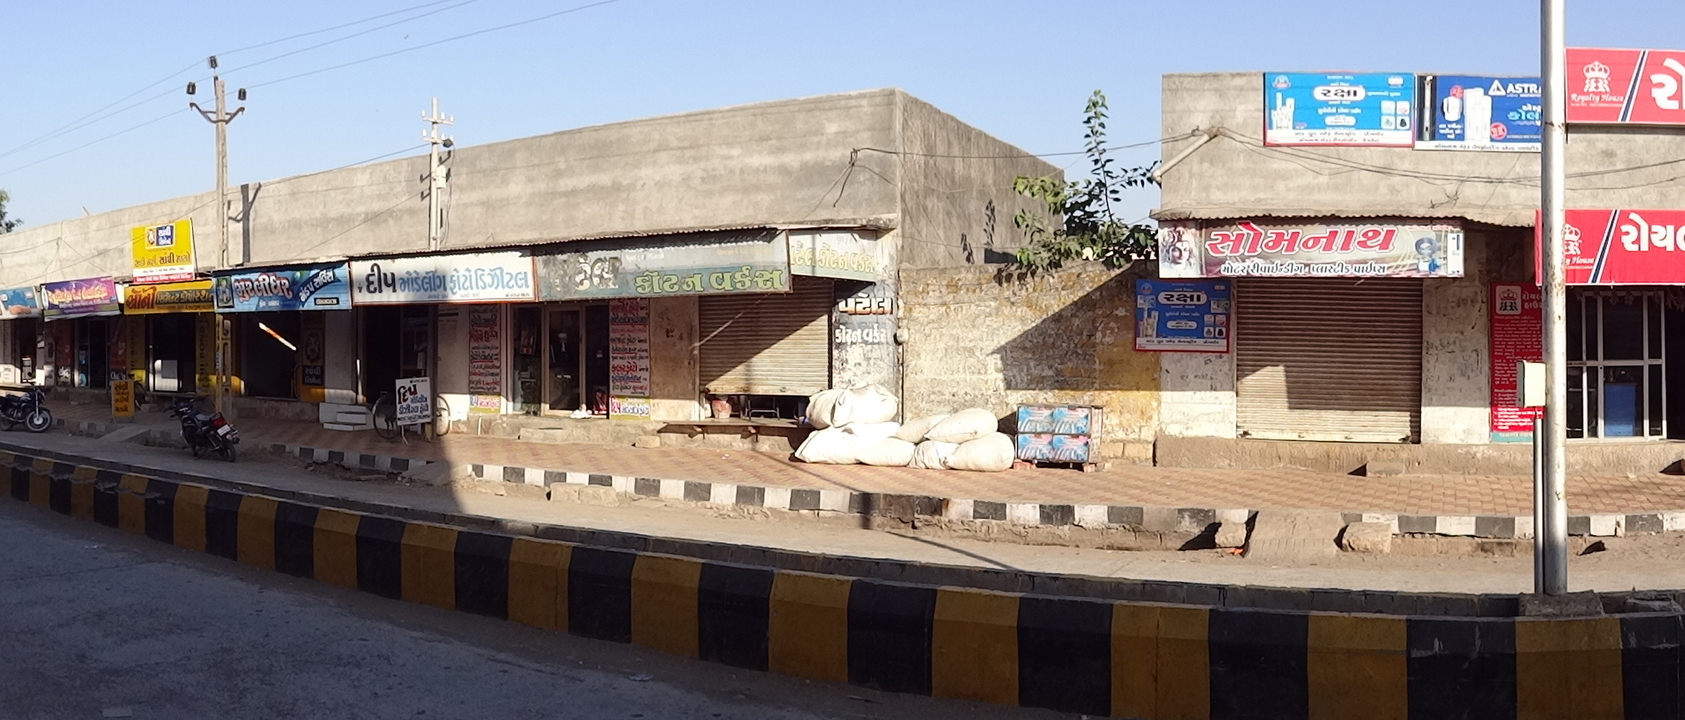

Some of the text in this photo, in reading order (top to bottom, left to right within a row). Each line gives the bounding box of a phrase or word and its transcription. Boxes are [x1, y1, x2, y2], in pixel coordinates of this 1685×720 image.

[1507, 83, 1541, 94] ASTR
[1206, 222, 1398, 256] સોમનાથ
[1222, 261, 1246, 275] મોટર
[365, 263, 397, 294] દીપ
[838, 292, 893, 316] પટેલ
[1163, 293, 1201, 303] રક્ષા
